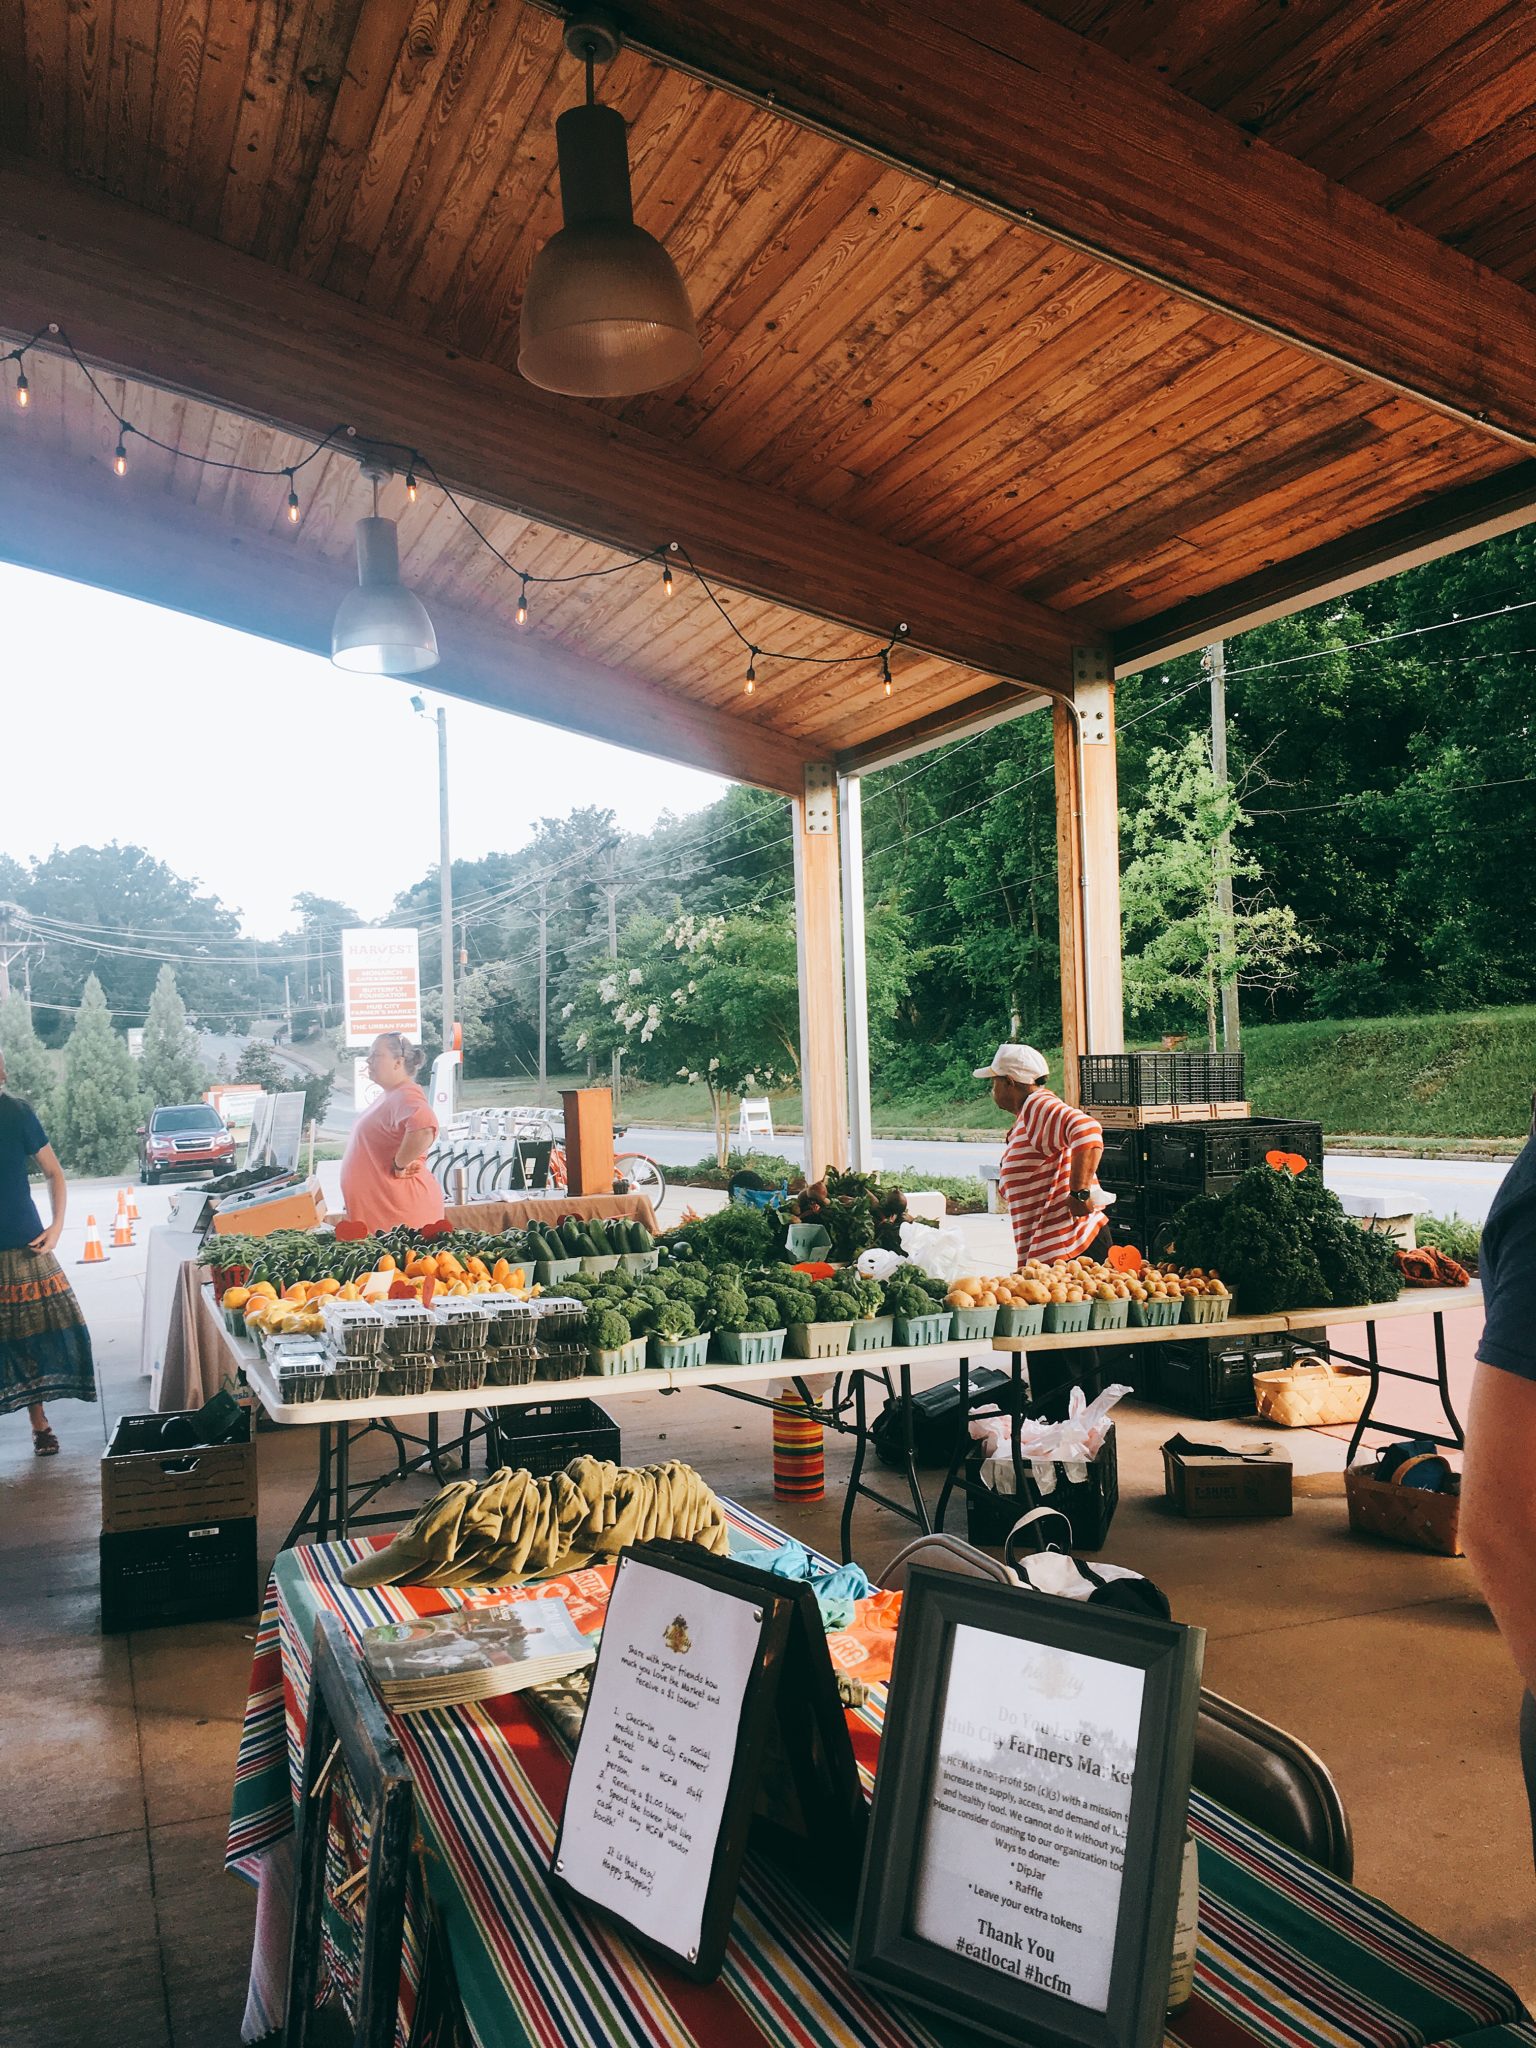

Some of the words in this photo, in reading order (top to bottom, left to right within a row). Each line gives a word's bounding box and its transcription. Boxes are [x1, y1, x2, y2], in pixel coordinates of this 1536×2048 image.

[350, 944, 414, 954] HARVEST
[621, 1657, 637, 1668] much
[638, 1666, 650, 1676] you
[669, 1676, 679, 1688] the
[681, 1683, 705, 1698] Market
[707, 1695, 720, 1704] and
[628, 1645, 644, 1659] Share
[646, 1655, 659, 1665] with
[661, 1662, 677, 1677] your
[678, 1664, 703, 1683] friends
[705, 1677, 718, 1689] how
[636, 1675, 659, 1693] receive
[677, 1693, 699, 1709] token!
[615, 1723, 634, 1736] media
[637, 1731, 644, 1742] to
[648, 1737, 659, 1749] Hub
[662, 1744, 676, 1762] City
[626, 1712, 654, 1731] Check-in
[690, 1745, 710, 1760] social
[998, 1705, 1018, 1723] Do
[1021, 1711, 1050, 1735] You
[945, 1715, 975, 1734] Hub
[1009, 1735, 1073, 1768] Farmers
[1077, 1754, 1132, 1785] Make
[943, 1770, 974, 1788] increase
[975, 1782, 988, 1793] the
[989, 1787, 1016, 1804] supply,
[1018, 1797, 1046, 1813] access,
[1047, 1807, 1064, 1818] and
[1065, 1811, 1100, 1830] demand
[1101, 1824, 1111, 1833] of
[969, 1763, 975, 1773] is
[1037, 1785, 1060, 1802] (c)(3)
[1062, 1795, 1081, 1807] with
[1082, 1801, 1088, 1809] a
[1089, 1803, 1122, 1820] mission
[933, 1798, 956, 1814] Please
[957, 1809, 989, 1826] consider
[990, 1820, 1026, 1842] donating
[1027, 1833, 1036, 1843] to
[1038, 1837, 1052, 1847] our
[1054, 1843, 1108, 1867] organization
[943, 1788, 958, 1798] and
[958, 1791, 986, 1810] healthy
[987, 1801, 1007, 1816] food.
[1009, 1809, 1022, 1821] We
[1024, 1816, 1052, 1831] cannot
[1053, 1824, 1065, 1835] do
[1066, 1827, 1073, 1838] it
[1074, 1833, 1109, 1850] without
[995, 1837, 1016, 1853] Ways
[1018, 1846, 1027, 1856] to
[1028, 1849, 1060, 1867] donate:
[1016, 1862, 1046, 1880] DipJar
[974, 1884, 999, 1902] Leave
[1000, 1897, 1022, 1910] your
[1023, 1905, 1048, 1921] extra
[1050, 1914, 1082, 1934] tokens
[1015, 1881, 1043, 1899] Raffle
[978, 1918, 1023, 1950] Thank
[1027, 1937, 1055, 1963] You
[956, 1936, 1021, 1976] #eatlocal
[1024, 1962, 1072, 1996] #hcfm
